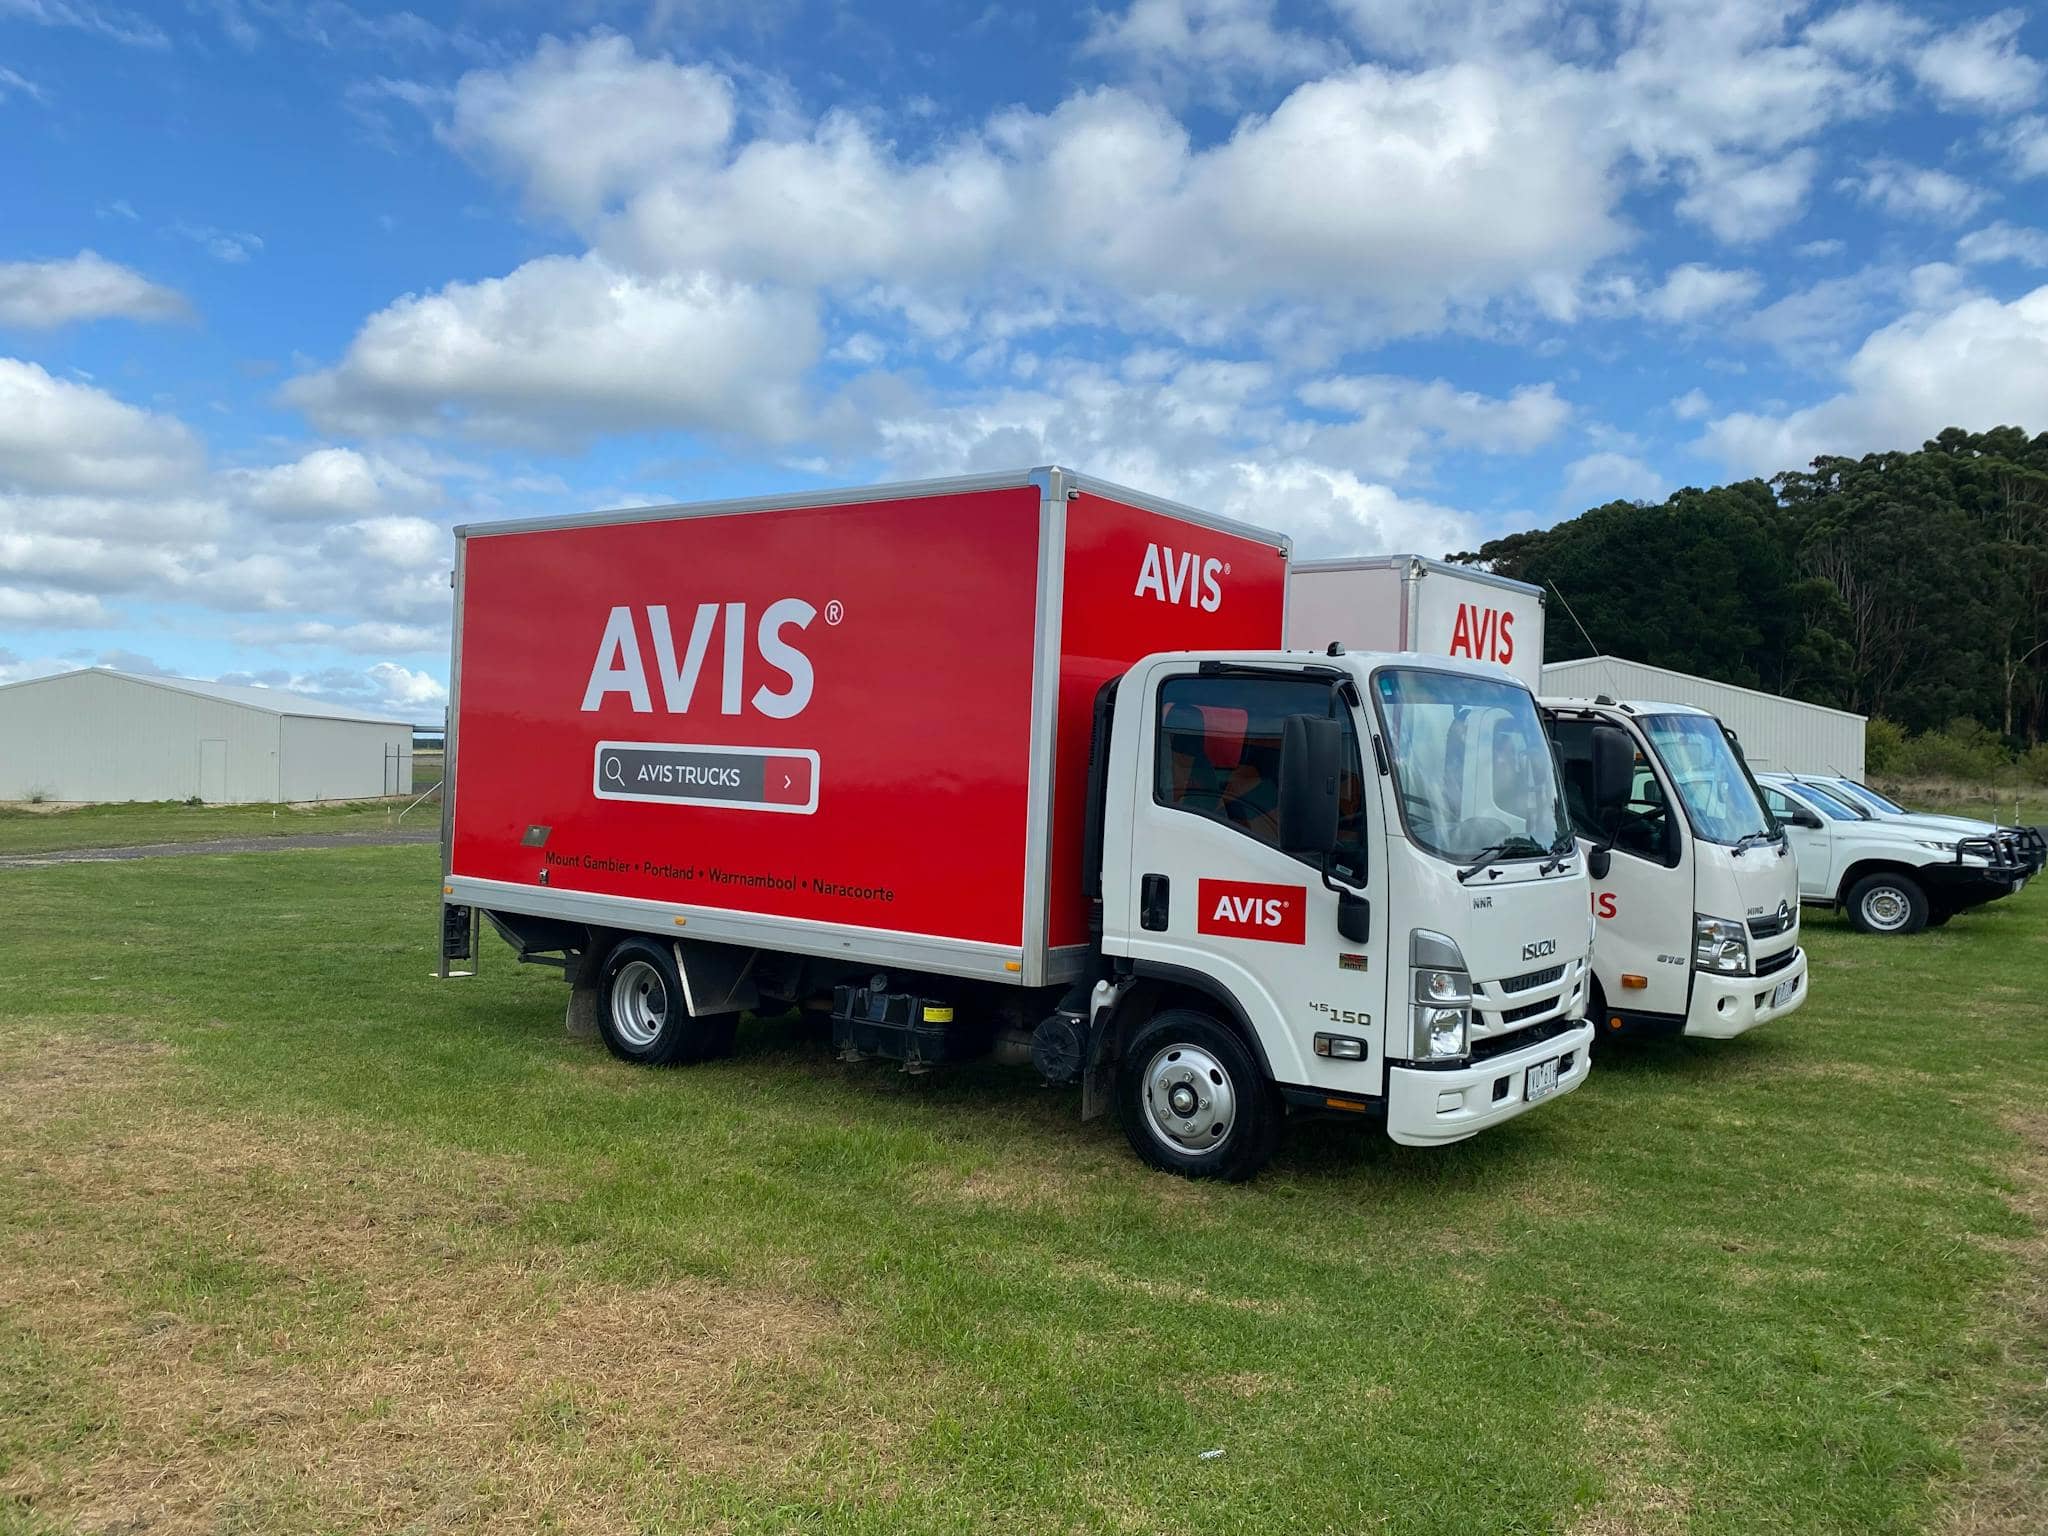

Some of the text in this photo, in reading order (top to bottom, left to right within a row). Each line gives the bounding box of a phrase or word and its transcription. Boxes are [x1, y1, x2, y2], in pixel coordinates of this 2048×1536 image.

[1449, 603, 1514, 665] AVIS
[636, 764, 741, 787] AVIS TRUCKS
[545, 851, 895, 902] Mount Gambier Portland Warrnambool Naracoorte
[1590, 892, 1617, 919] IS
[1522, 939, 1556, 961] ISUZU
[1309, 1001, 1371, 1026] 45 150
